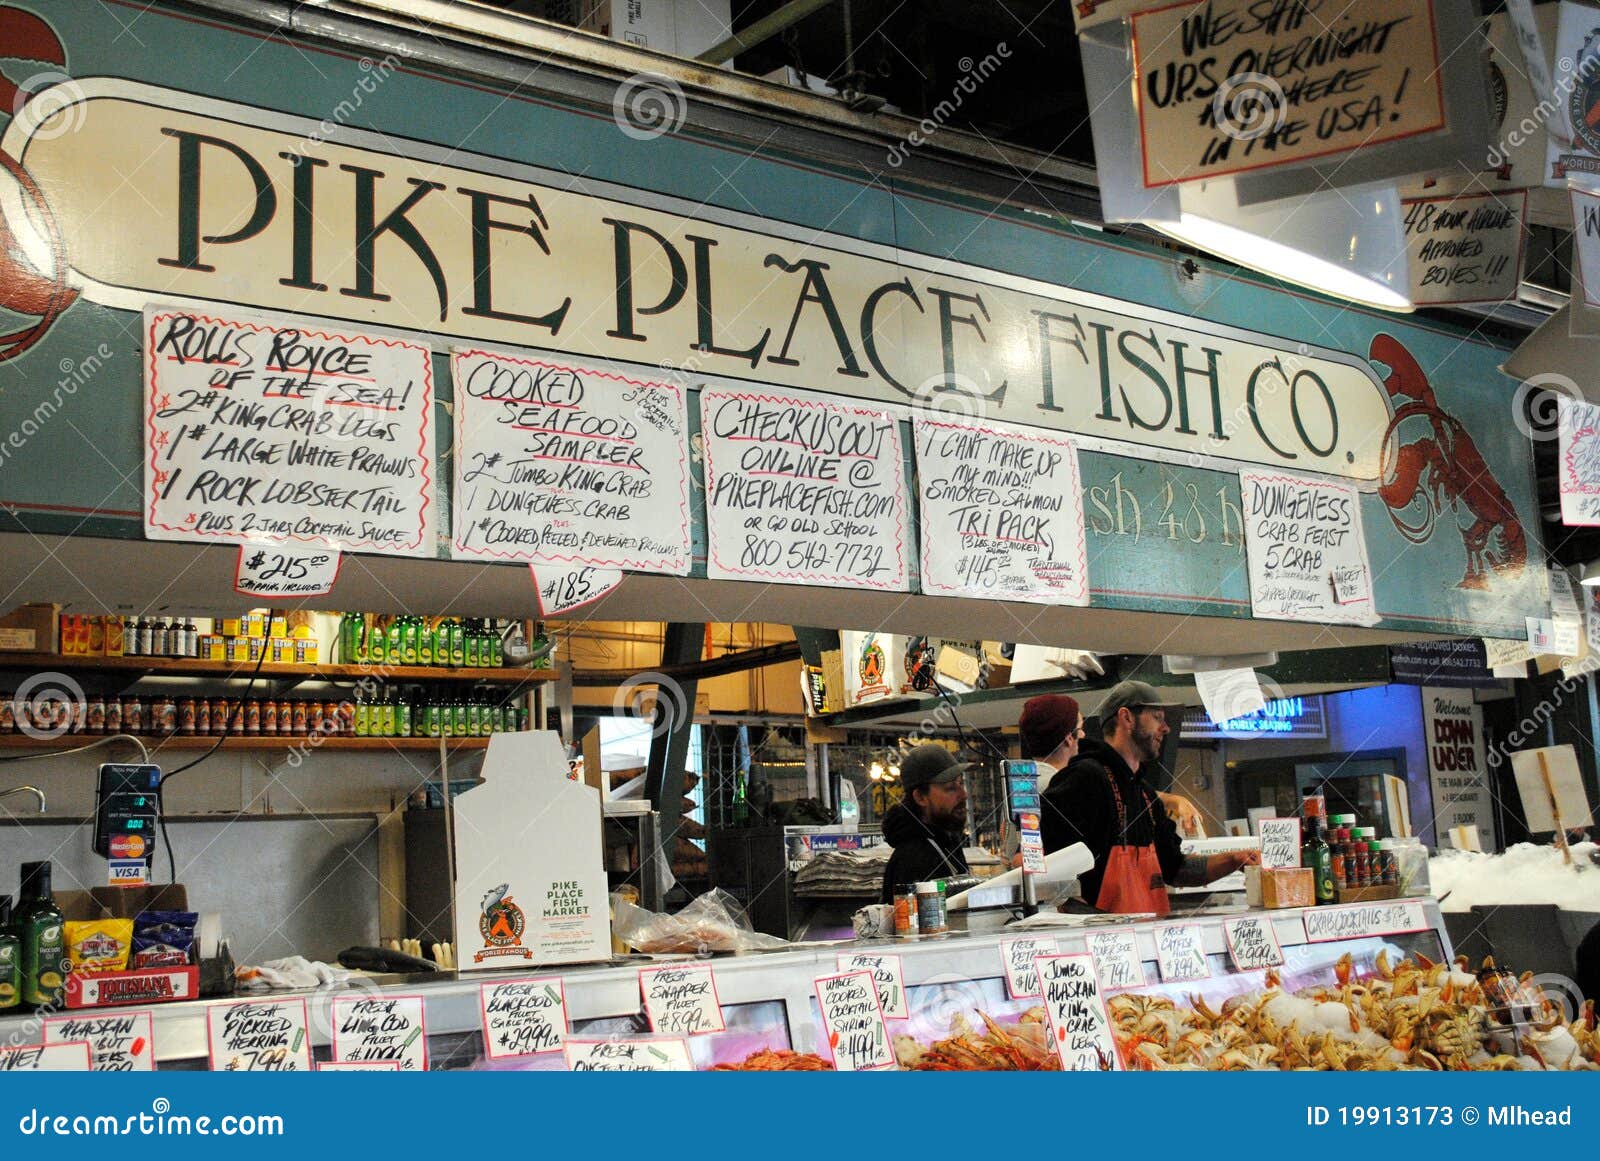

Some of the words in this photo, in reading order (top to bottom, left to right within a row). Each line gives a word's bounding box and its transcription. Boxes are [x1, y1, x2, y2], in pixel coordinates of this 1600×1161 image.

[1226, 16, 1413, 86] OVERNIGHT
[1316, 67, 1412, 140] USA!
[1403, 203, 1438, 235] 48
[157, 127, 571, 336] PIKE
[602, 217, 1008, 408] PLACE
[1031, 309, 1230, 440] FISH
[1246, 355, 1355, 464] CO.
[156, 316, 257, 368] ROLLS
[265, 329, 373, 384] ROYCE
[208, 368, 255, 390] OF
[262, 376, 322, 399] THE
[466, 360, 585, 408] COOKED
[211, 397, 268, 433] KING
[268, 403, 333, 437] CRAB
[338, 412, 401, 441] LEGS
[496, 400, 639, 441] SEAFOOD
[202, 432, 283, 466] LARGE
[288, 440, 346, 468] WHITE
[348, 446, 417, 479] PRAWNS
[524, 431, 651, 475] SAMPLER
[987, 439, 1033, 468] MAKE
[1037, 450, 1062, 478] UP
[494, 458, 559, 486] JUMBO
[557, 462, 606, 494] KING
[604, 470, 654, 499] CRAB
[741, 445, 842, 480] ONLINE
[849, 458, 883, 490] @
[951, 463, 980, 488] MY
[185, 470, 262, 507] ROCK
[261, 478, 362, 510] LOBSTER
[359, 486, 408, 516] TAIL
[486, 486, 585, 517] DUNGENESS
[583, 499, 632, 521] CRAB
[712, 471, 896, 519] PIKEPLACEFISH.COM
[925, 478, 1001, 507] SMOKED
[1001, 488, 1064, 513] SALMON
[1251, 480, 1352, 526] DUNGENESS
[1157, 480, 1207, 543] 48
[194, 512, 234, 531] PLUS
[240, 512, 256, 532] 2
[256, 519, 293, 537] JARS
[293, 517, 356, 537] COCKTAIL
[358, 522, 410, 543] SAUCE
[743, 516, 763, 532] OR
[766, 514, 789, 533] GO
[791, 517, 820, 534] OLD
[823, 519, 879, 538] SCHOOL
[948, 505, 992, 537] TRI
[995, 509, 1051, 548] PACK
[1256, 519, 1300, 544] CRAB
[1303, 525, 1350, 548] FEAST
[741, 534, 782, 568] 800
[1264, 543, 1285, 570] 5
[1282, 546, 1323, 570] CRAB
[1434, 698, 1473, 716] Welcome
[1434, 718, 1475, 745] DOWN
[1433, 746, 1477, 772] UNDER
[115, 868, 140, 878] VISA
[552, 881, 579, 891] PIKE
[546, 889, 584, 900] PLACE
[552, 898, 579, 908] FISH
[542, 906, 590, 917] MARKET
[653, 970, 697, 984] FRESH
[1044, 958, 1085, 980] JUMBO
[97, 975, 175, 1001] LOUISIANA
[491, 984, 535, 997] FRESH
[649, 981, 711, 999] SNAPPER
[825, 986, 868, 1005] COOKED
[1047, 979, 1097, 1003] ALASKAN
[224, 1002, 287, 1021] FRESH
[508, 1010, 541, 1019] FILLET
[666, 998, 701, 1010] FILLET
[829, 1000, 878, 1019] COCKTAIL
[1058, 1000, 1088, 1020] KING
[60, 1015, 137, 1039] ALASKAN
[222, 1016, 293, 1038] PICKLED
[379, 1013, 410, 1033] COD
[833, 1016, 873, 1033] SHRIMP
[1066, 1017, 1097, 1034] CRAB
[227, 1032, 289, 1051] HERRING
